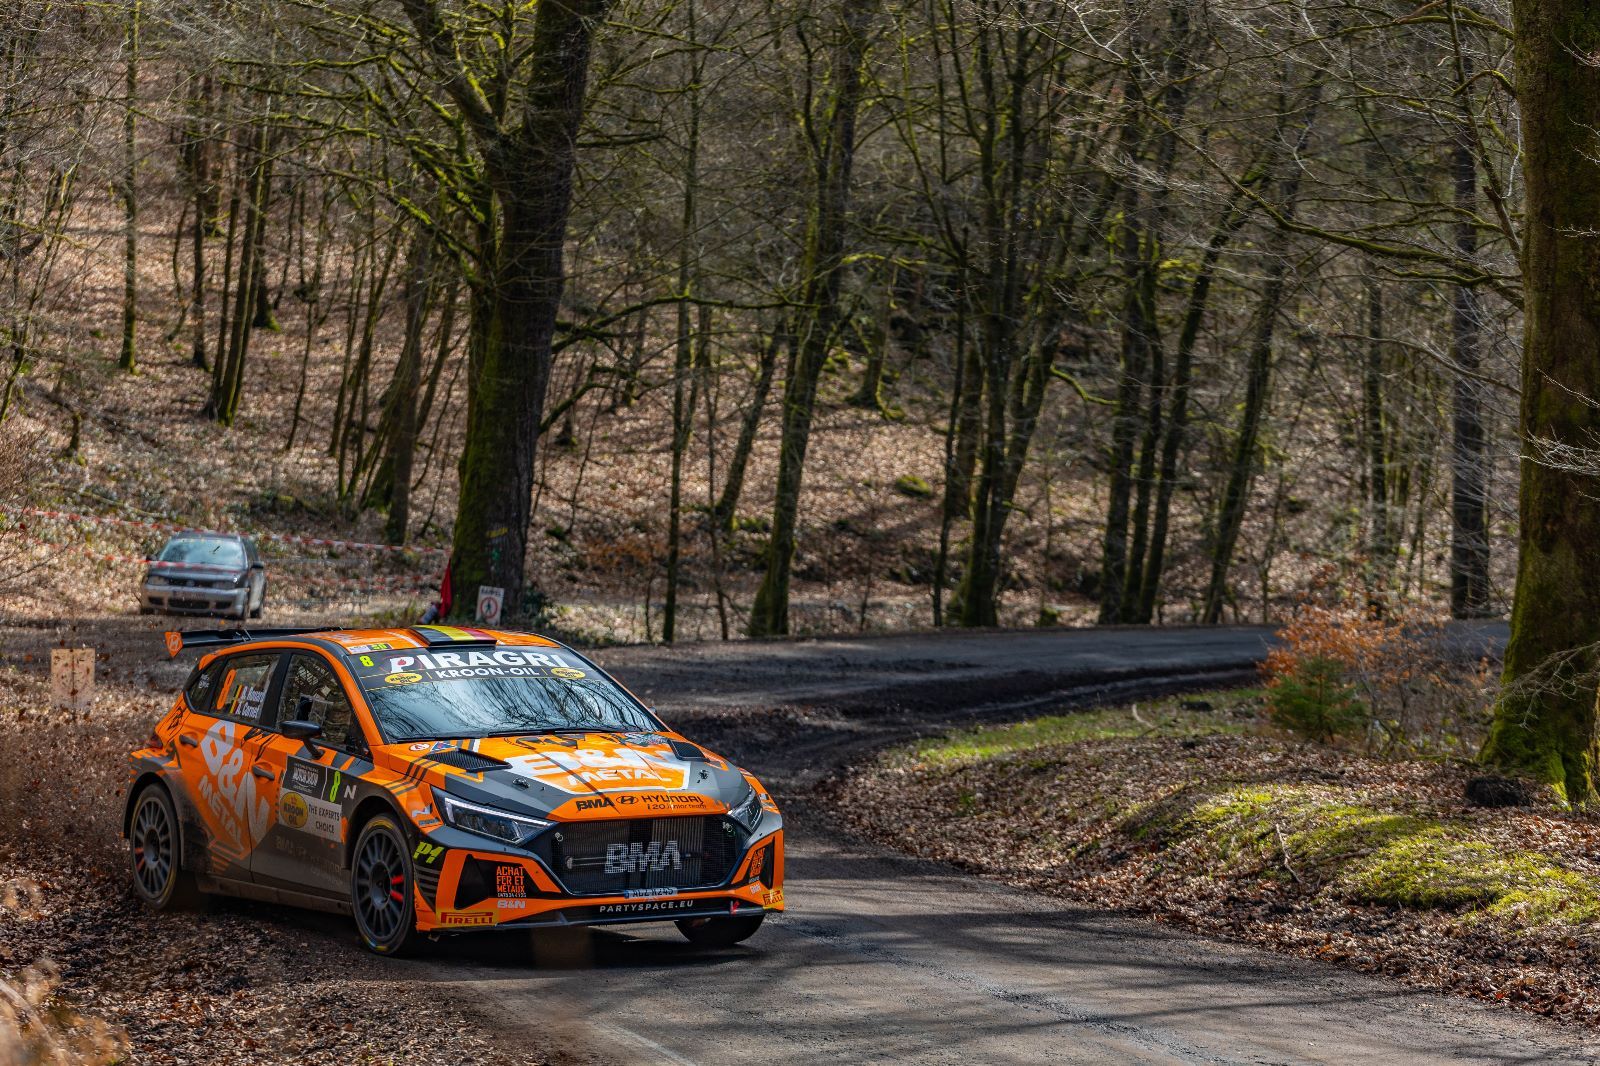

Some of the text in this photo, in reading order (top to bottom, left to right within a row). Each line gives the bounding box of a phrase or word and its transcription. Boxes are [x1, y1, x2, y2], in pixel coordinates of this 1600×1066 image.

[360, 655, 374, 667] 8
[390, 651, 570, 673] PIRAGRI
[435, 667, 540, 678] KROON-OIL
[200, 719, 270, 844] B&N
[330, 770, 341, 803] 8
[343, 784, 357, 799] N
[576, 796, 615, 811] BMA
[641, 794, 704, 804] HYUNDAI
[308, 803, 340, 822] THE EXPERTS
[315, 821, 335, 834] CHOICE
[413, 842, 445, 864] P1
[605, 841, 682, 873] BMA
[496, 866, 524, 876] ACHAT
[496, 876, 525, 886] FER ET
[497, 900, 526, 909] B&N
[600, 900, 694, 913] PARTYSPACE.EU
[440, 912, 494, 924] PIRELLI
